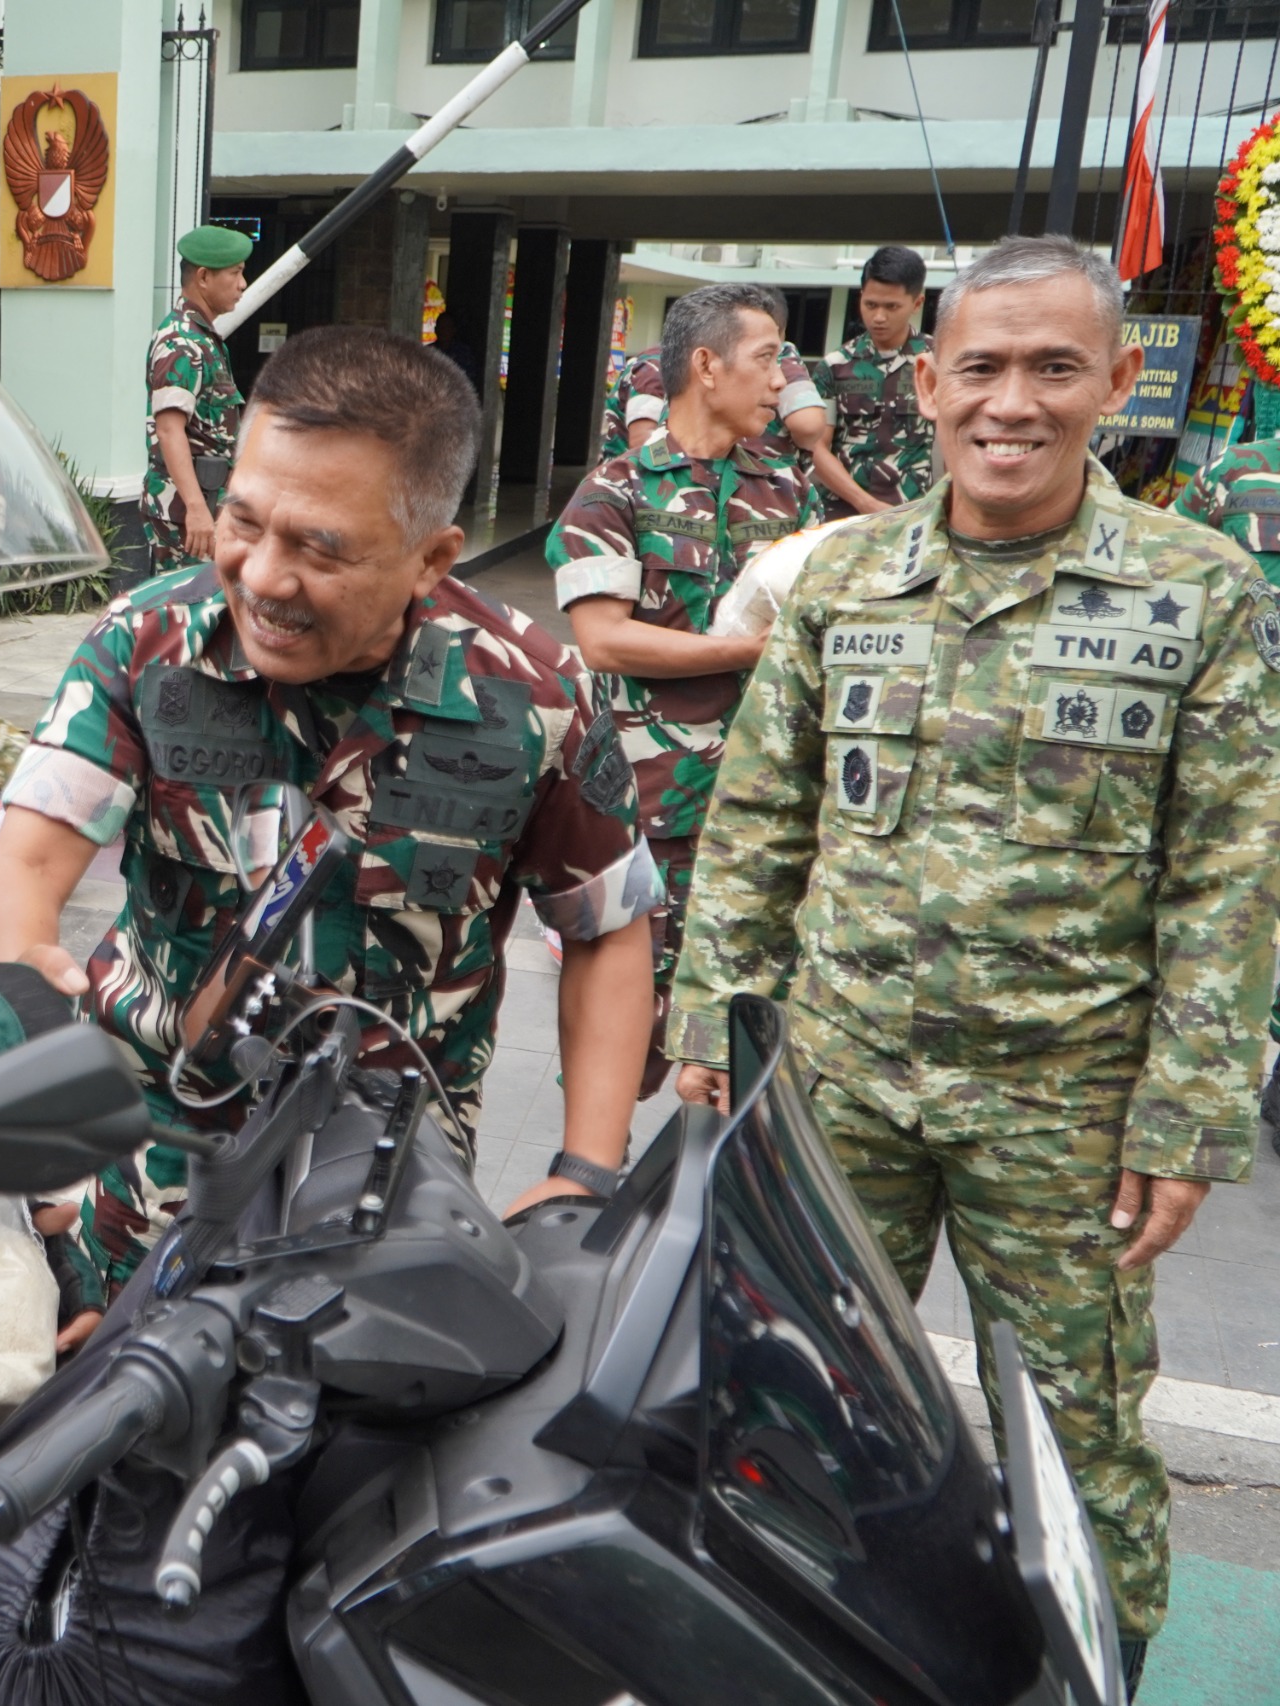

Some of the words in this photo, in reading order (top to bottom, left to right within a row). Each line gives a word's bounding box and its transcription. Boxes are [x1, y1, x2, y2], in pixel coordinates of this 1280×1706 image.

[1139, 385, 1173, 398] HITAM
[1141, 416, 1175, 429] SOPAN
[647, 513, 705, 535] SLAMET
[832, 632, 905, 655] BAGUS
[1054, 634, 1117, 661] TNI
[1130, 643, 1184, 671] AD
[389, 789, 458, 828] TNI
[472, 806, 519, 834] AD
